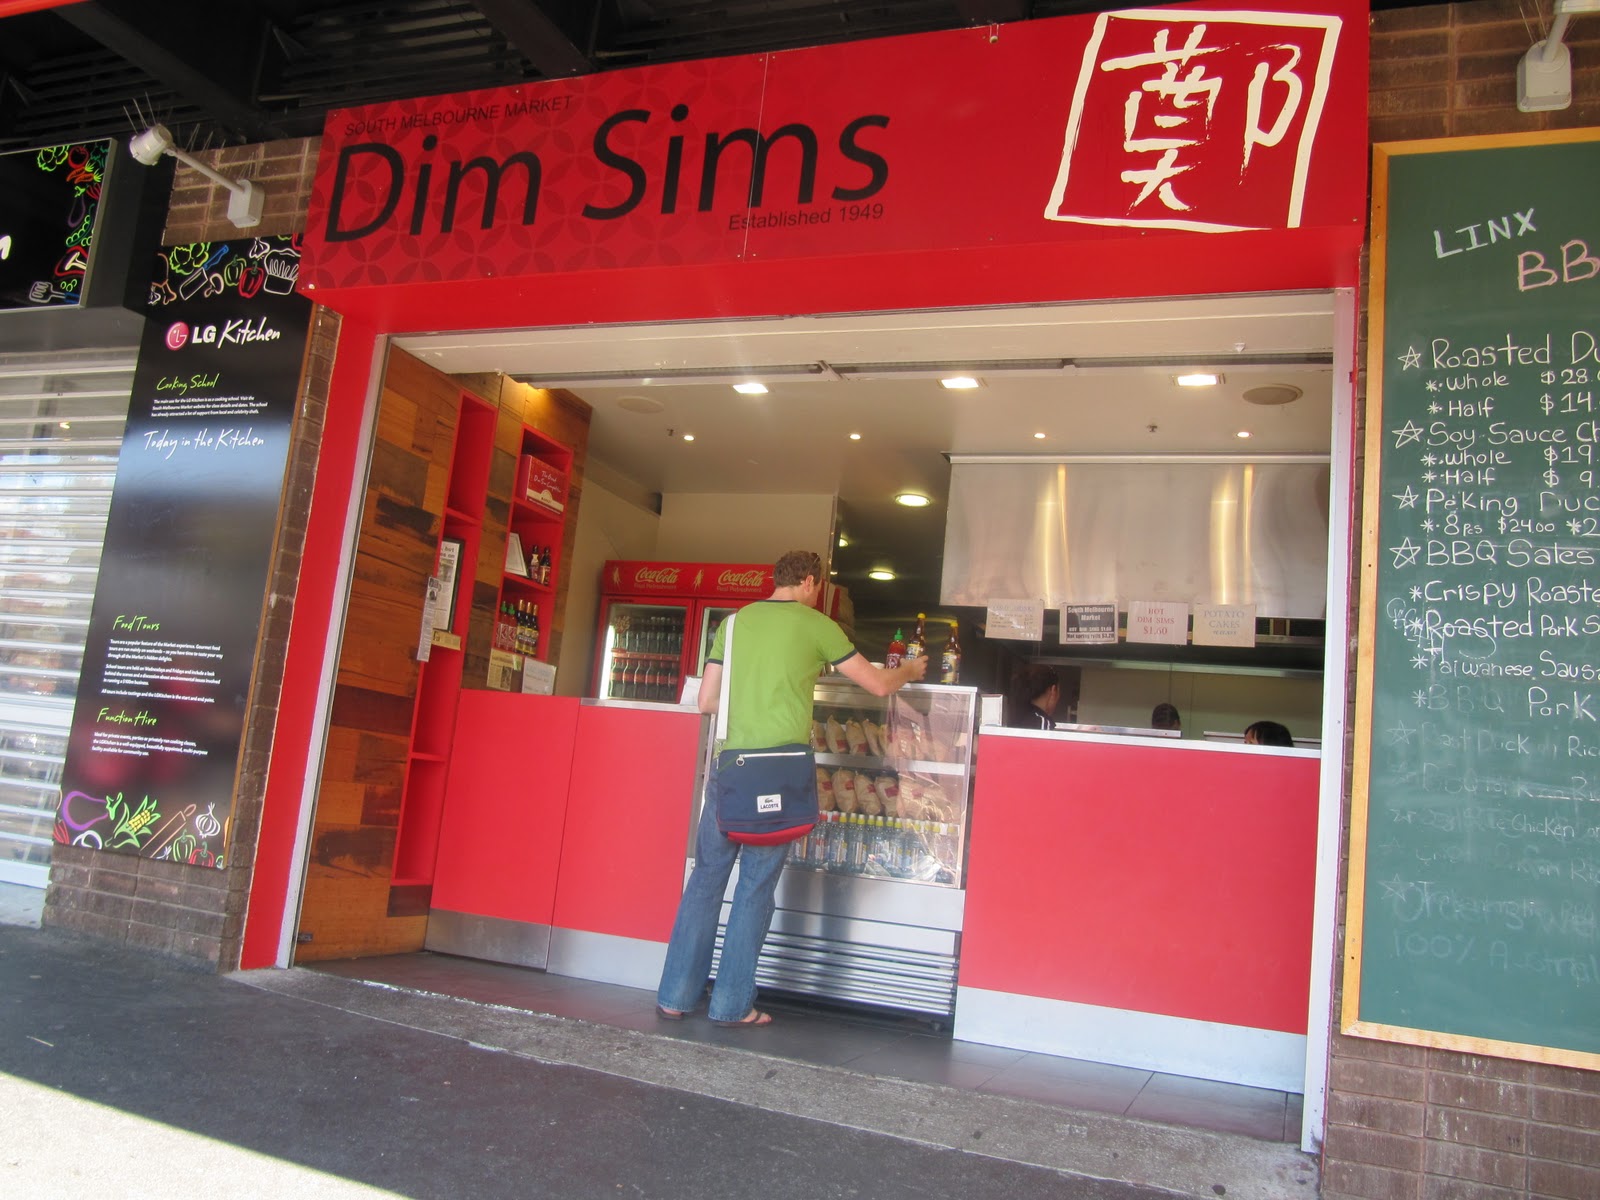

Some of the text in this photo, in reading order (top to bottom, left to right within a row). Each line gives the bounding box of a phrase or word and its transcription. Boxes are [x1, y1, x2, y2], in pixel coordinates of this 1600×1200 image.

[344, 95, 573, 136] SOUTH MELBOURNE MARKET
[324, 103, 890, 242] Dim Sims
[728, 203, 884, 230] Established 1949
[1433, 208, 1537, 258] LINX
[1518, 239, 1600, 291] BB
[192, 316, 281, 349] LG Kitchen
[1432, 333, 1550, 369] Roasted
[156, 373, 220, 395] Cooking School
[1448, 396, 1494, 418] Half
[144, 427, 264, 460] Today in the Kitchen
[1427, 422, 1475, 451] Soy
[1488, 422, 1567, 445] Sauce
[1445, 467, 1495, 486] Half
[1498, 517, 1555, 535] $24.00
[1426, 538, 1595, 567] BBQ Sales
[635, 567, 681, 584] Coca-Cola
[718, 570, 767, 587] Coca-Cola
[1424, 580, 1516, 608] Crispy
[1067, 606, 1084, 614] South
[1156, 617, 1175, 625] SIMS
[1204, 610, 1245, 618] POTATO
[112, 614, 160, 632] Food Tours
[1143, 626, 1168, 636] $1.60
[1208, 620, 1240, 629] CAKES
[1425, 609, 1533, 639] Roasted
[1427, 684, 1504, 713] BBQ
[96, 707, 157, 727] Function Hire
